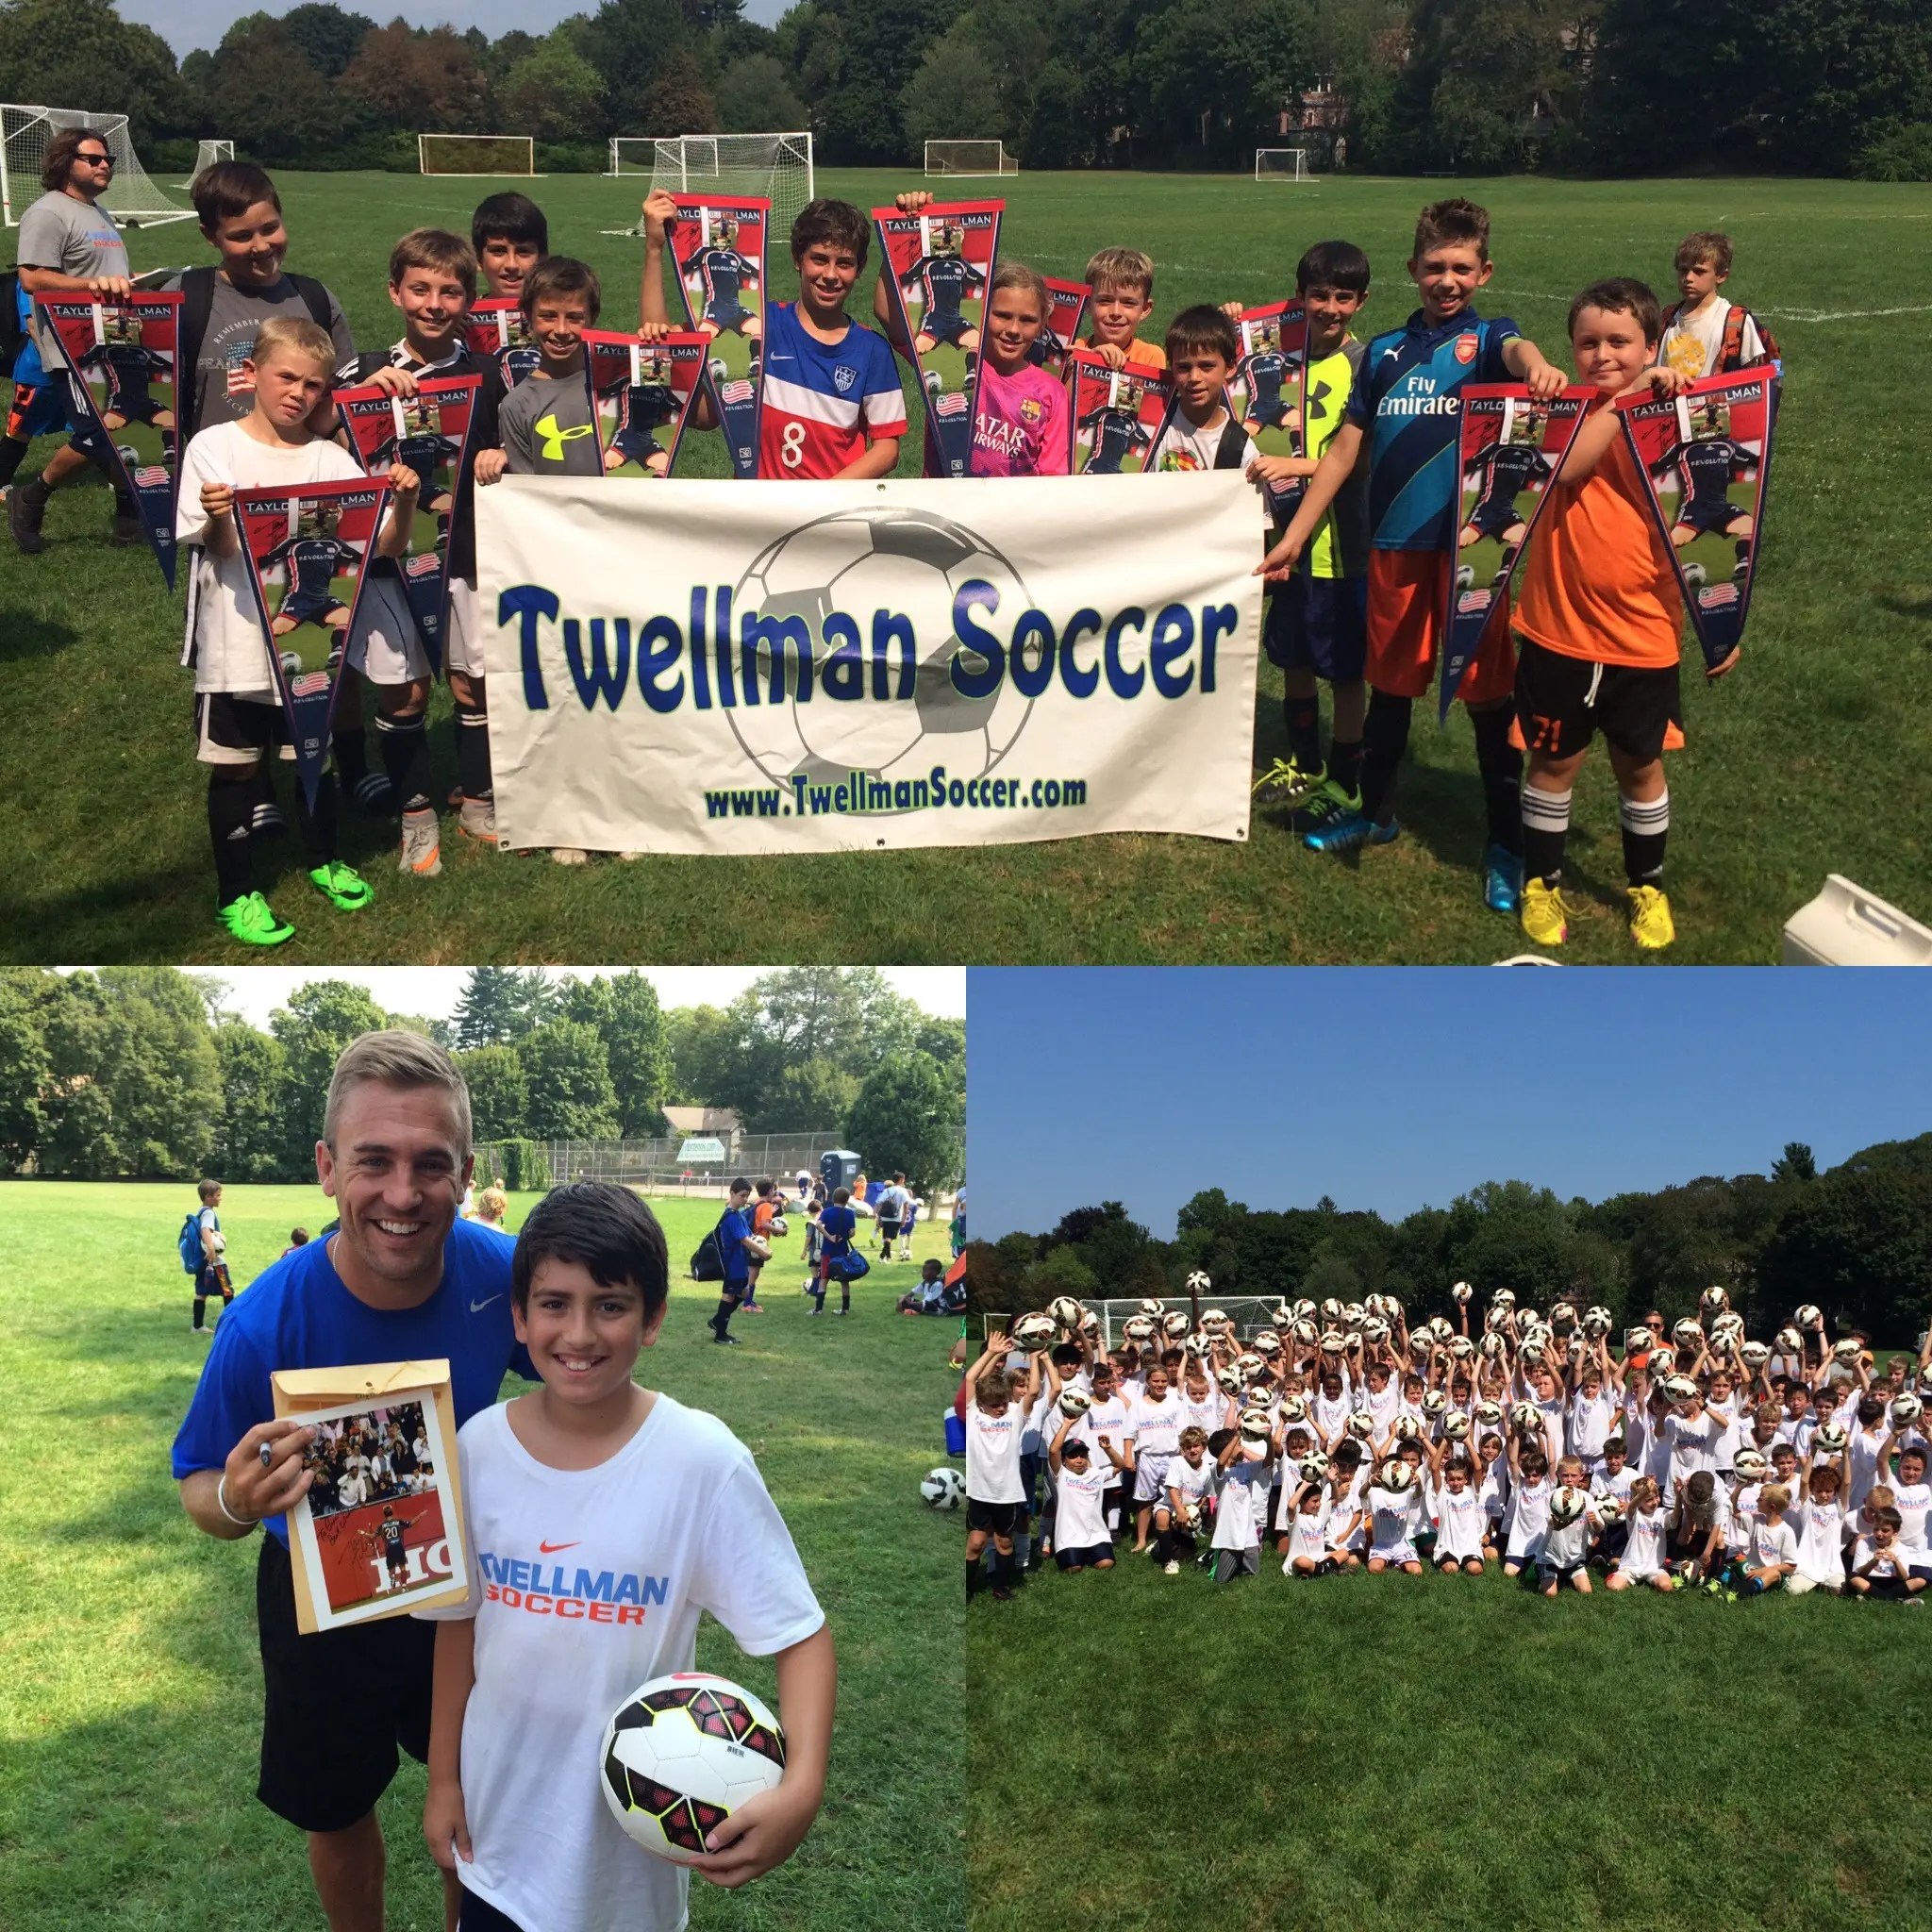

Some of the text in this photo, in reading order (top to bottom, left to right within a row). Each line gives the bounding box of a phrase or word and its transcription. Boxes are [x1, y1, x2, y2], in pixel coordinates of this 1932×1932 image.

[212, 318, 261, 344] REMEMBER
[1407, 376, 1437, 395] Fly
[350, 401, 391, 413] TAYLO
[1376, 392, 1461, 417] Emirate
[1632, 385, 1761, 418] TAYLO LMAN
[781, 421, 807, 469] 8
[341, 493, 375, 506] LMAN
[498, 578, 1239, 713] Twellman Soccer
[705, 765, 1089, 820] www.TwellmanSoccer.com
[385, 1526, 398, 1539] 20
[486, 1584, 646, 1625] SOCCER
